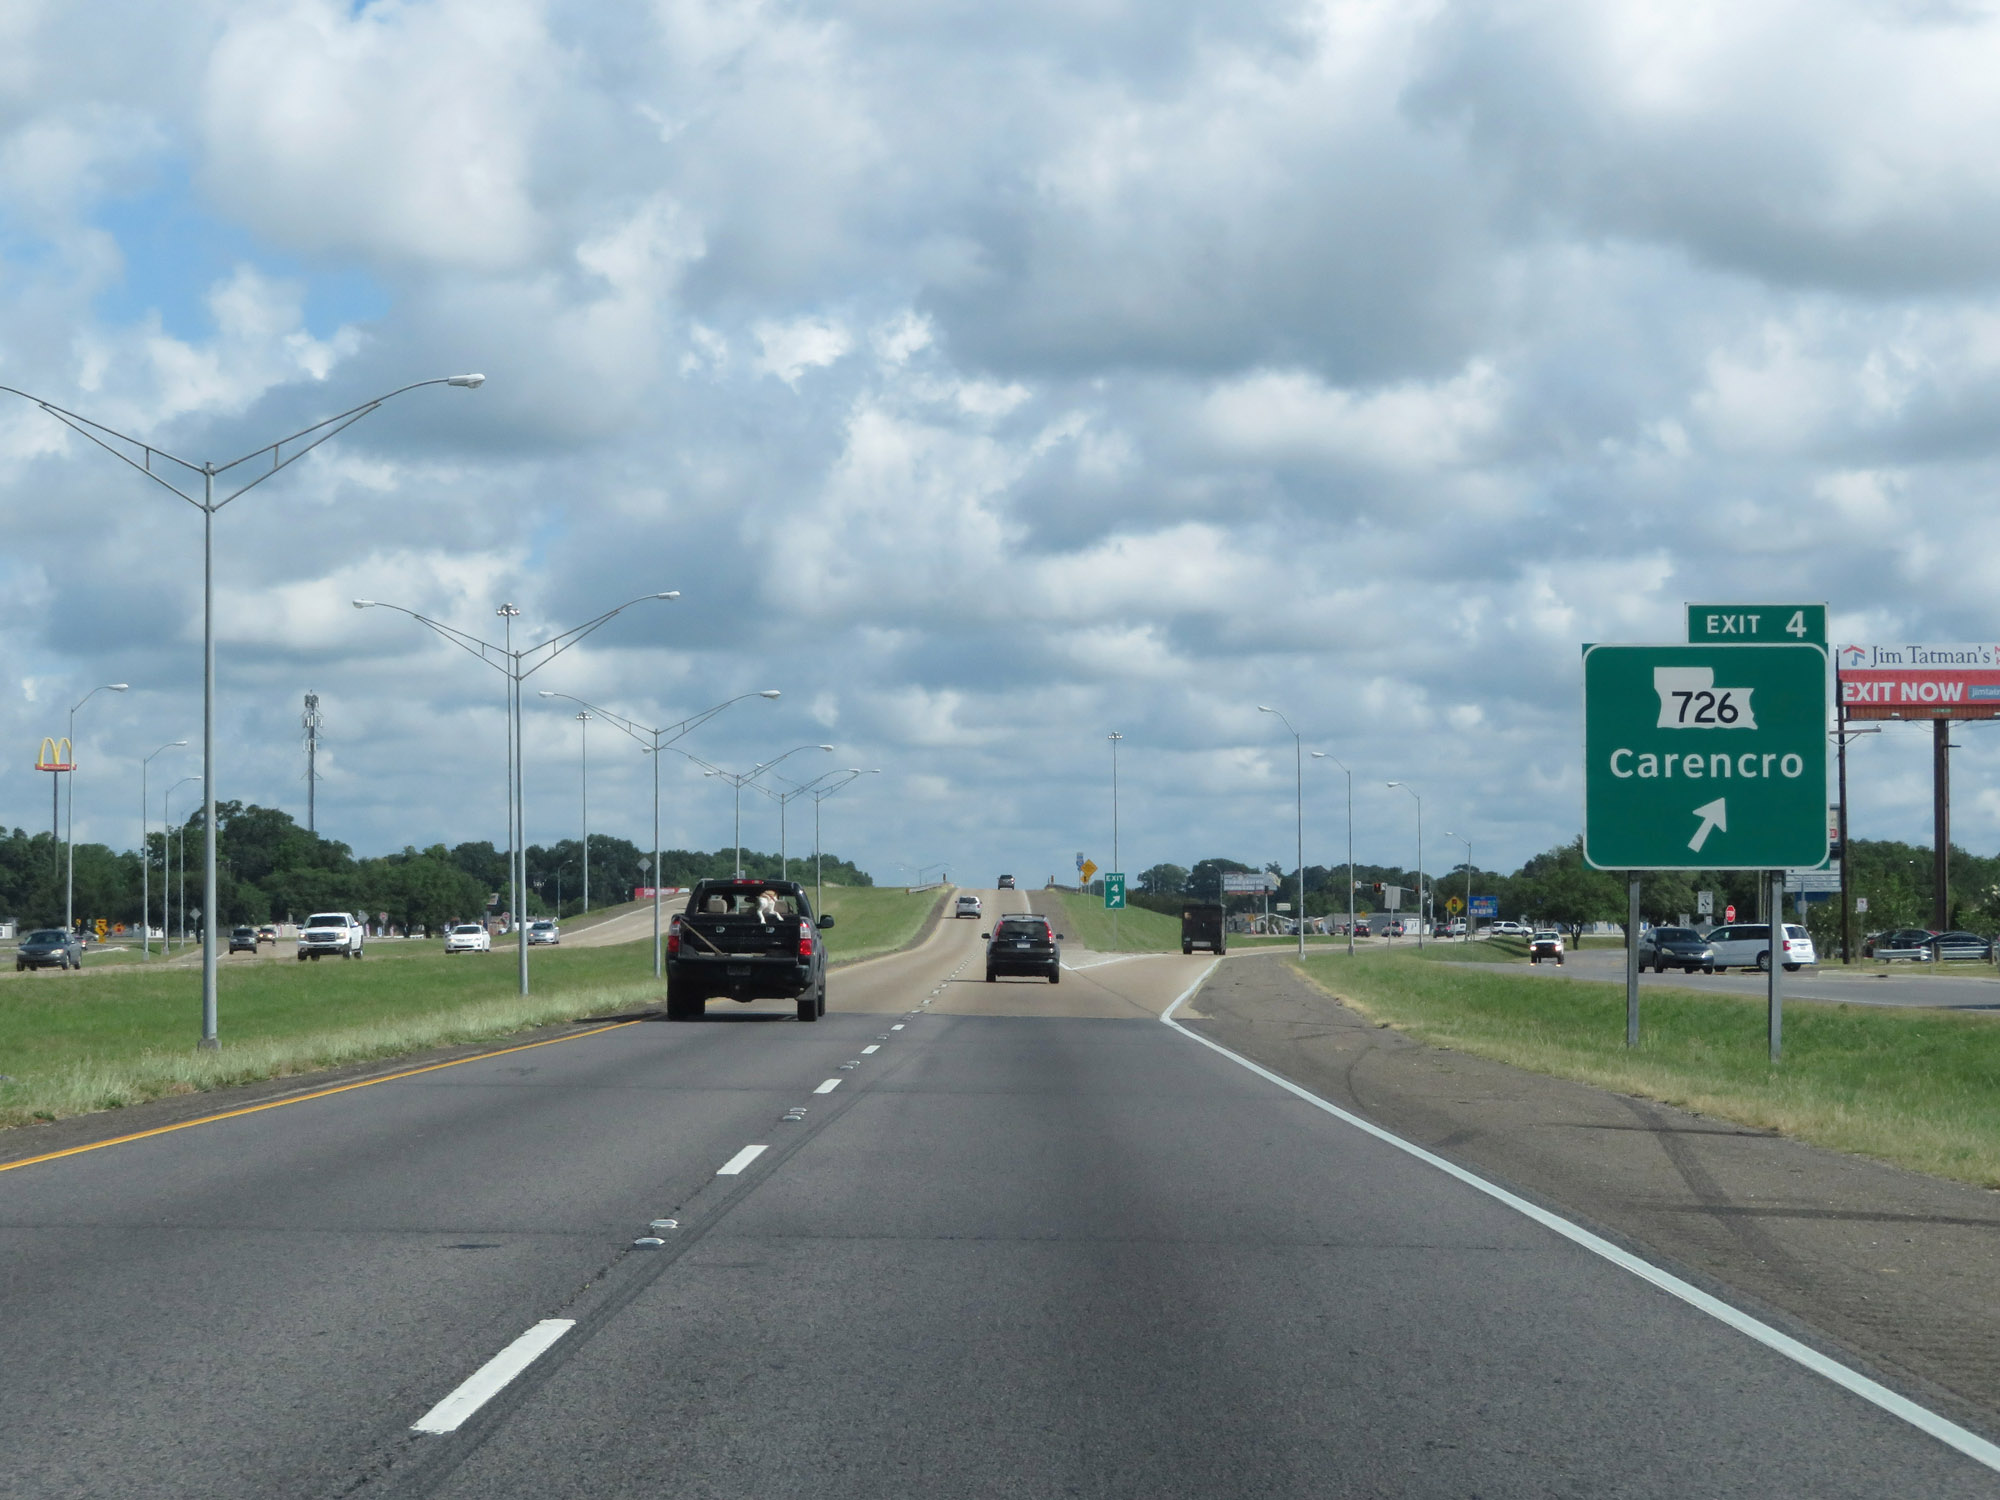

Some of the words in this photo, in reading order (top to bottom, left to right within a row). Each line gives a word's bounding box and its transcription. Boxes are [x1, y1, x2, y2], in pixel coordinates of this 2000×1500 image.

[1706, 614, 1761, 634] EXIT
[1785, 610, 1807, 638] 4
[1870, 645, 1903, 668] Jim
[1905, 645, 1991, 664] Tatman's
[1843, 682, 1896, 702] EXIT
[1900, 682, 1964, 702] NOW
[1671, 690, 1739, 724] 726
[1610, 748, 1804, 778] Carencro
[1111, 884, 1119, 893] 4
